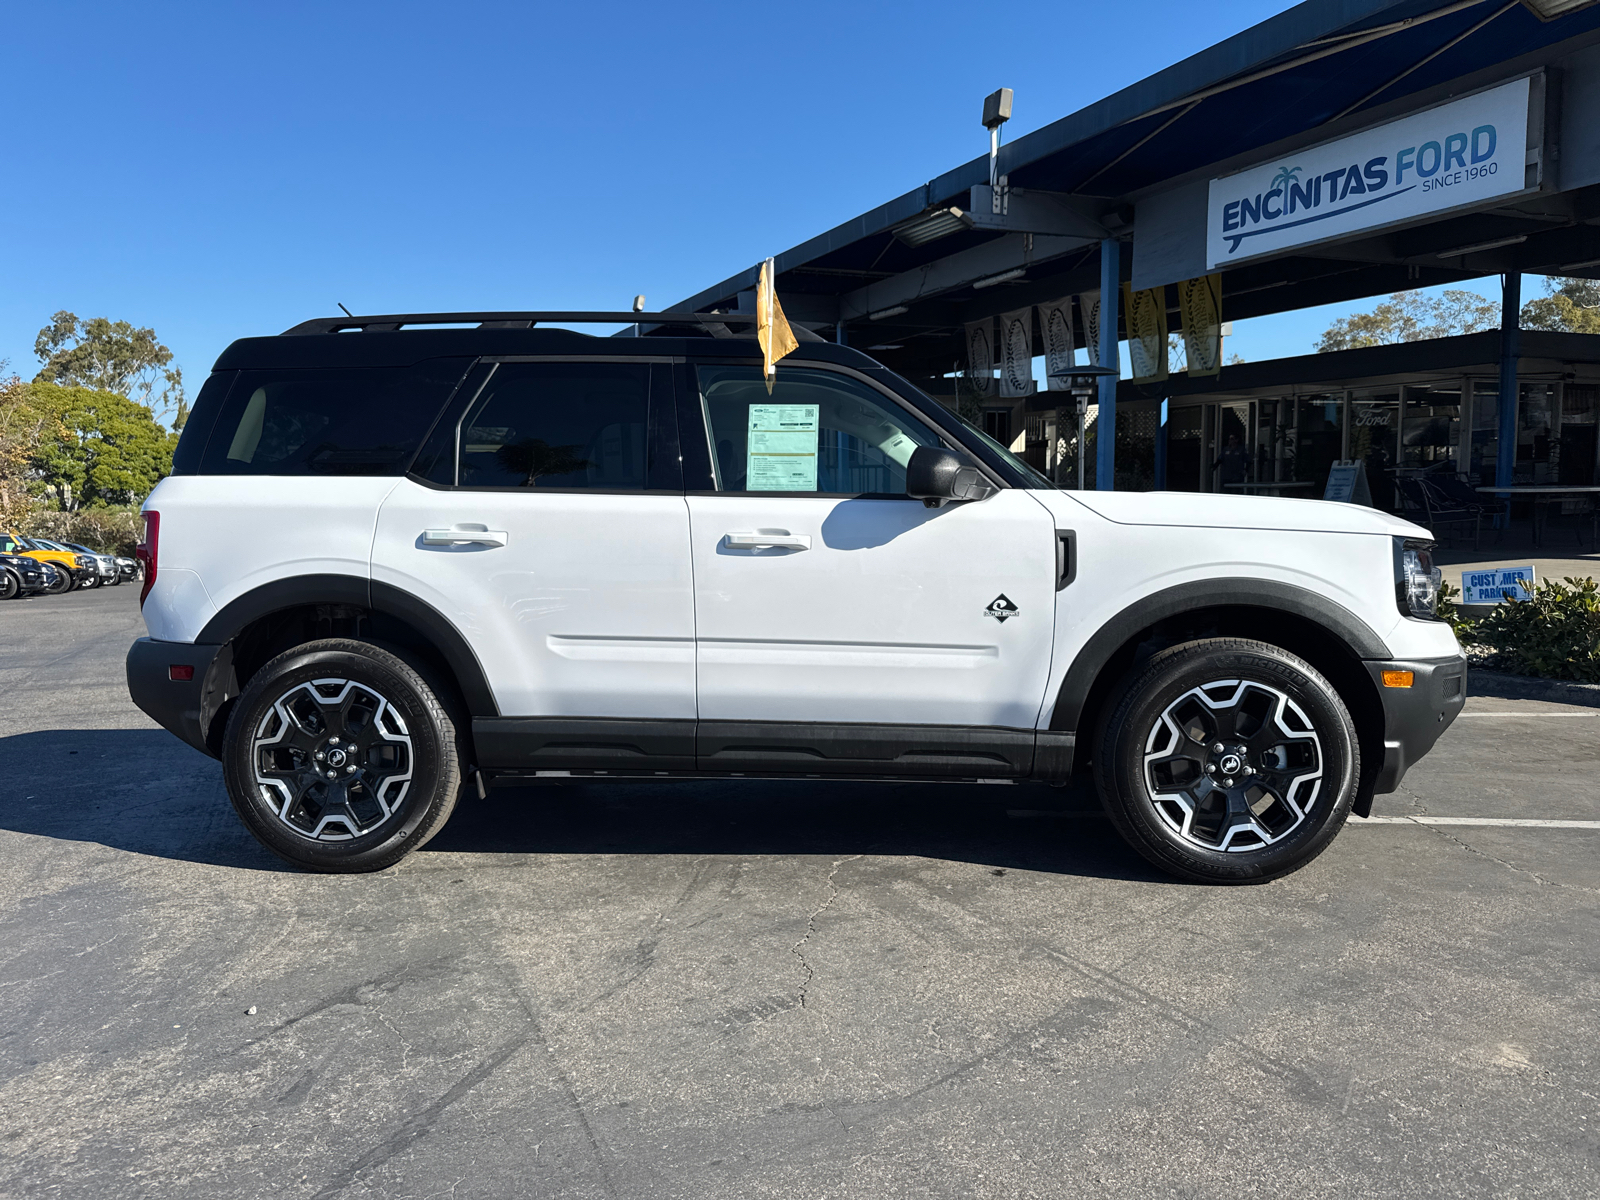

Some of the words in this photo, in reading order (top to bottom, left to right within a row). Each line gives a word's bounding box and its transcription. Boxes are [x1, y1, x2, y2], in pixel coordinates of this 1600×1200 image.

[1223, 156, 1388, 232] ENCINITAS
[1395, 124, 1497, 185] FORD
[1422, 173, 1461, 193] SINCE
[1465, 162, 1498, 182] 1960
[1355, 408, 1391, 427] Ford
[1471, 572, 1524, 587] CUSTMER
[1239, 655, 1308, 687] MICHELIN
